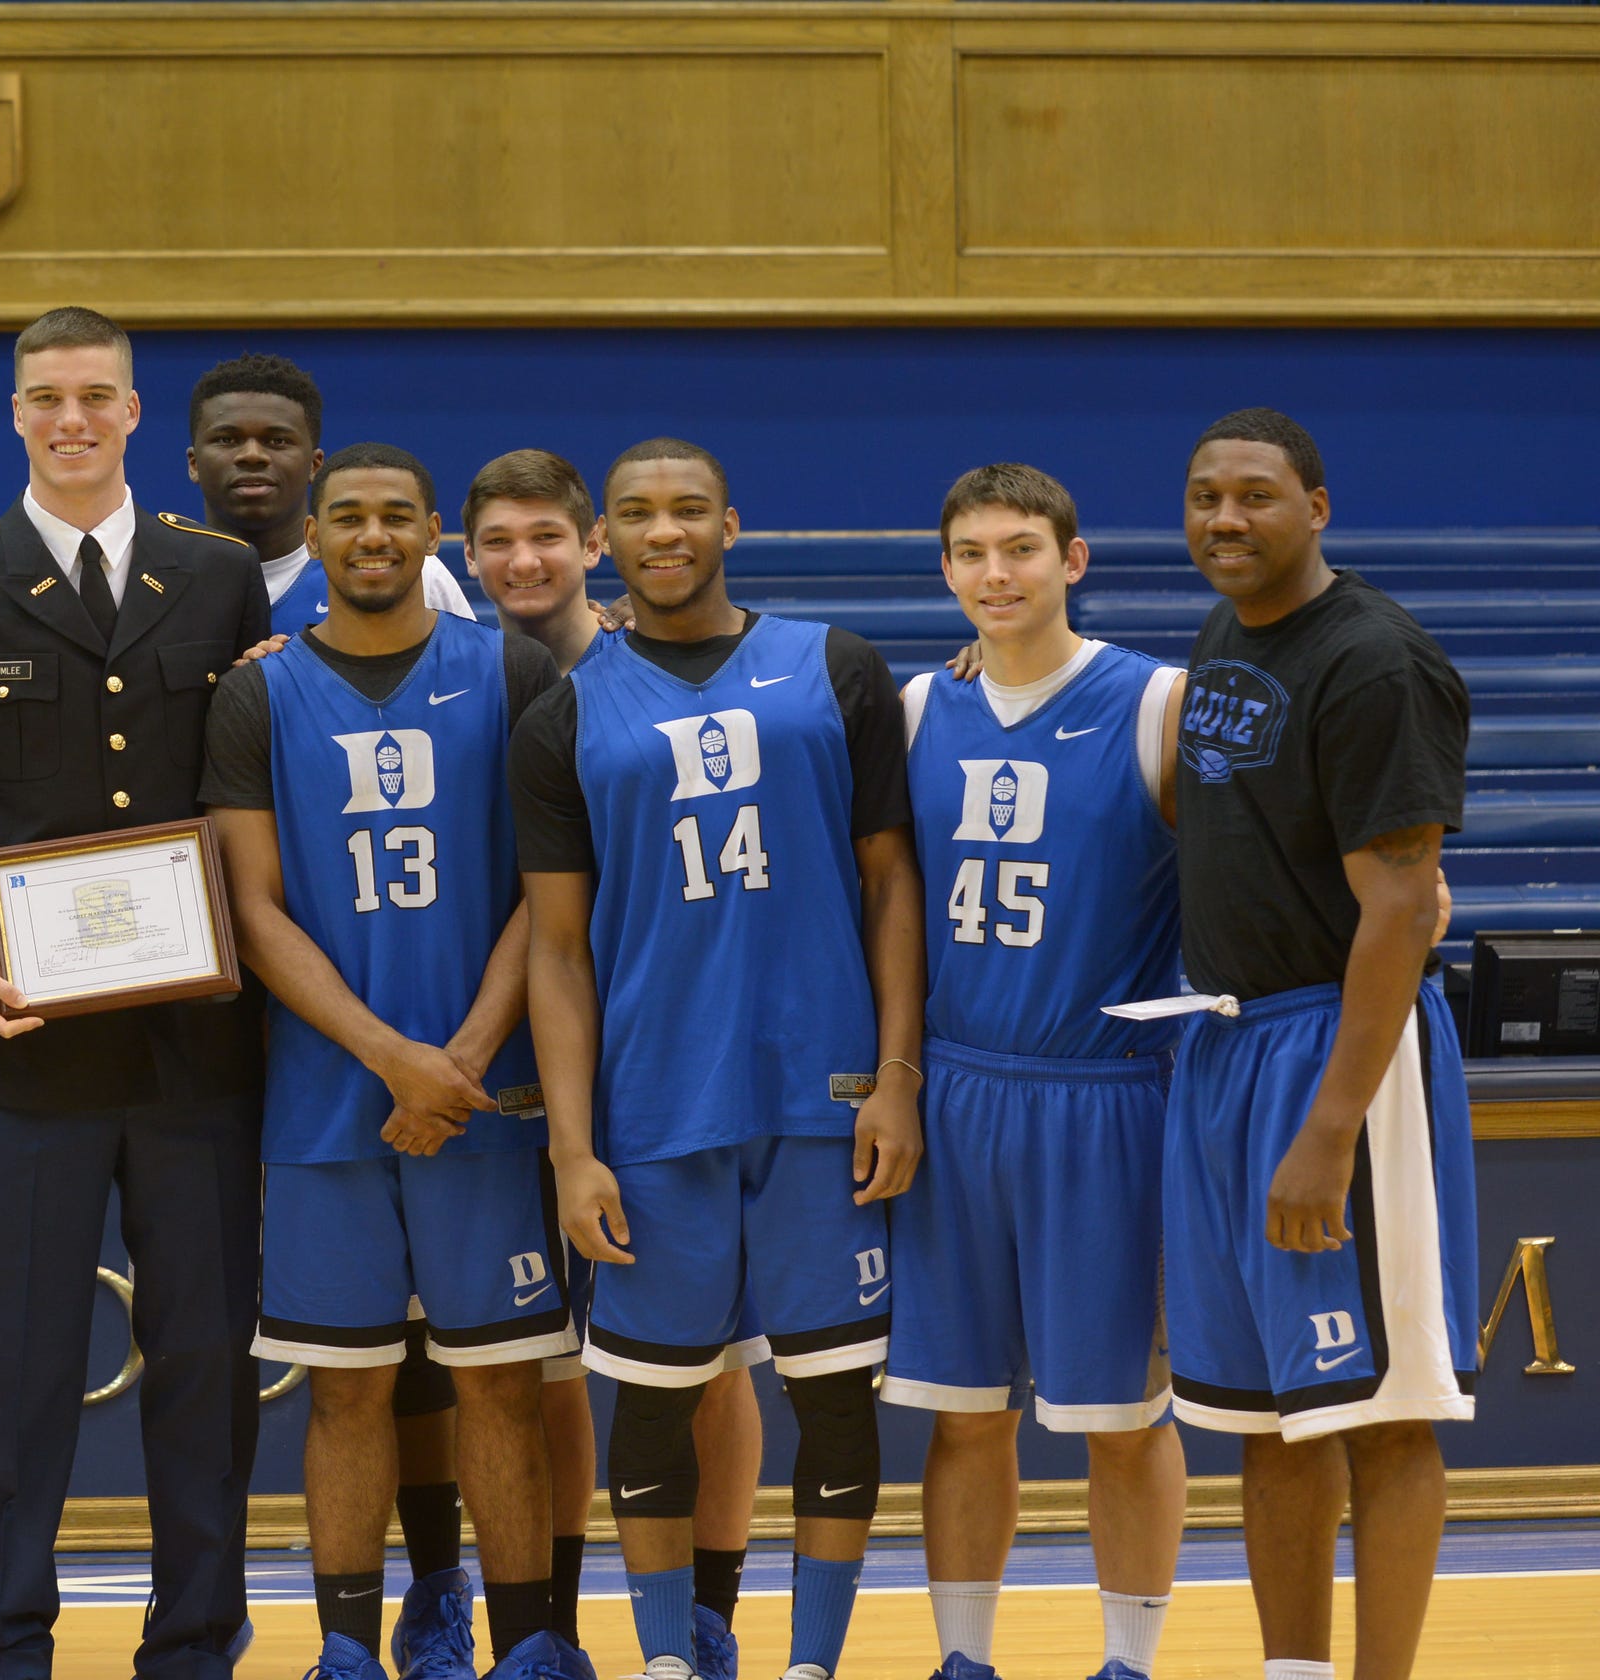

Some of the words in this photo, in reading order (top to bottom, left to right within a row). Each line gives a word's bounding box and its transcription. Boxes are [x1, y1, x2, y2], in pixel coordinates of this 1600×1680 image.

[331, 728, 436, 814] D
[652, 708, 761, 802] D
[951, 758, 1050, 843] D
[347, 825, 438, 914] 13
[672, 804, 771, 902] 14
[947, 858, 1050, 948] 45
[508, 1251, 546, 1288] D
[855, 1247, 886, 1286] D
[1308, 1310, 1356, 1350] D
